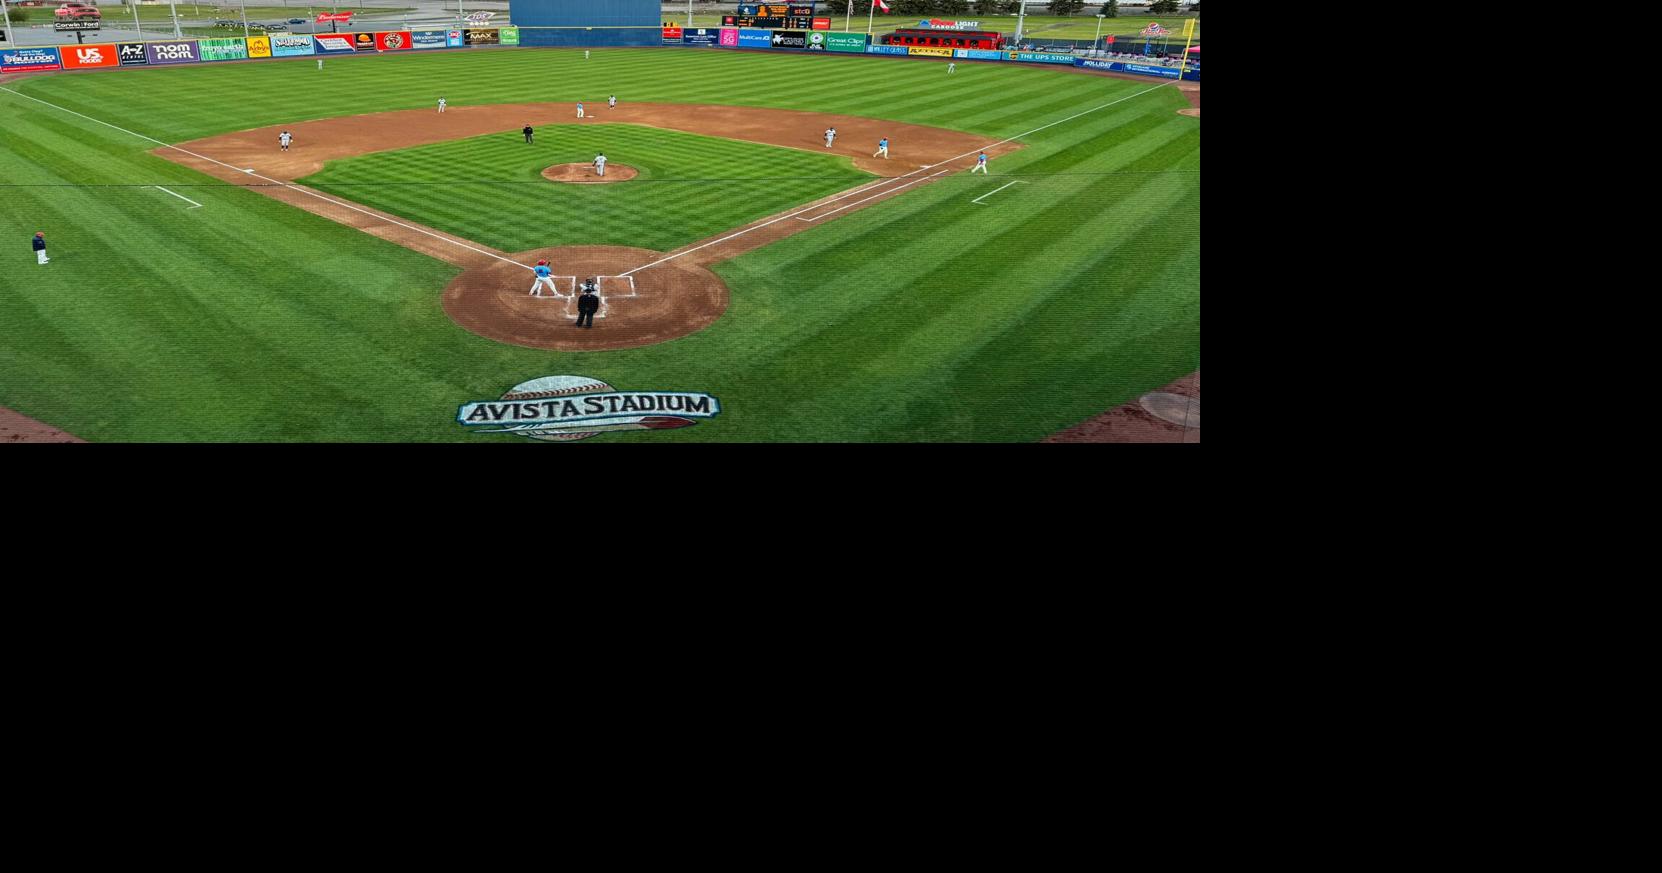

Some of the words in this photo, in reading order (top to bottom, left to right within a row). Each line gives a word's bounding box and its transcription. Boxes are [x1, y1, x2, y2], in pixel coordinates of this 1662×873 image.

[152, 43, 191, 53] nom
[157, 51, 195, 60] nom
[1051, 54, 1074, 62] STORE
[1083, 60, 1114, 69] HOLLIDAY
[466, 401, 578, 422] AVISTA
[583, 394, 711, 416] STADIUM
